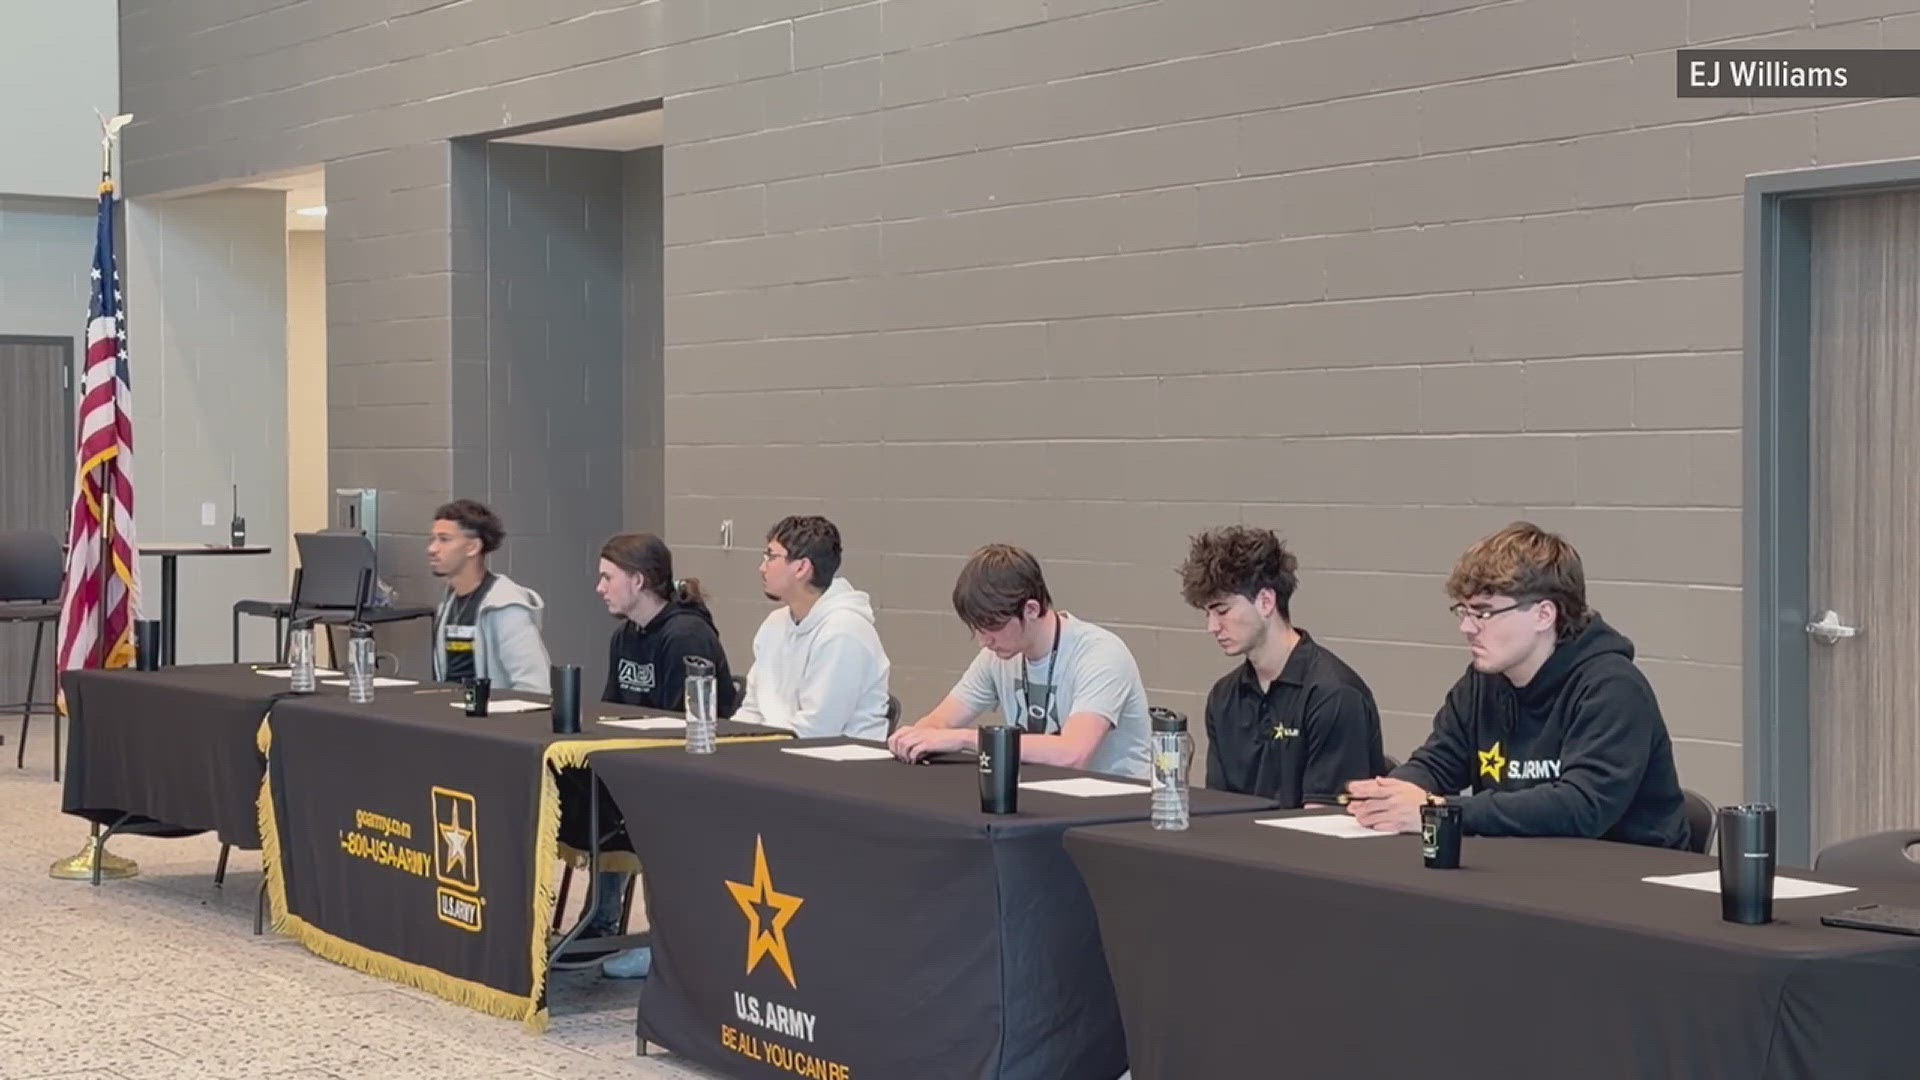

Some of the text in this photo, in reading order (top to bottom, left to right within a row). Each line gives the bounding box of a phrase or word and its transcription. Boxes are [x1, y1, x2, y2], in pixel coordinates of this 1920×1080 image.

[356, 809, 411, 839] goarmy.com
[340, 830, 432, 877] -800-USA-ARMY
[766, 1002, 815, 1042] ARMY
[722, 1024, 737, 1049] BE
[738, 1032, 762, 1060] ALL
[763, 1040, 793, 1070] YOU
[795, 1052, 828, 1080] CAN
